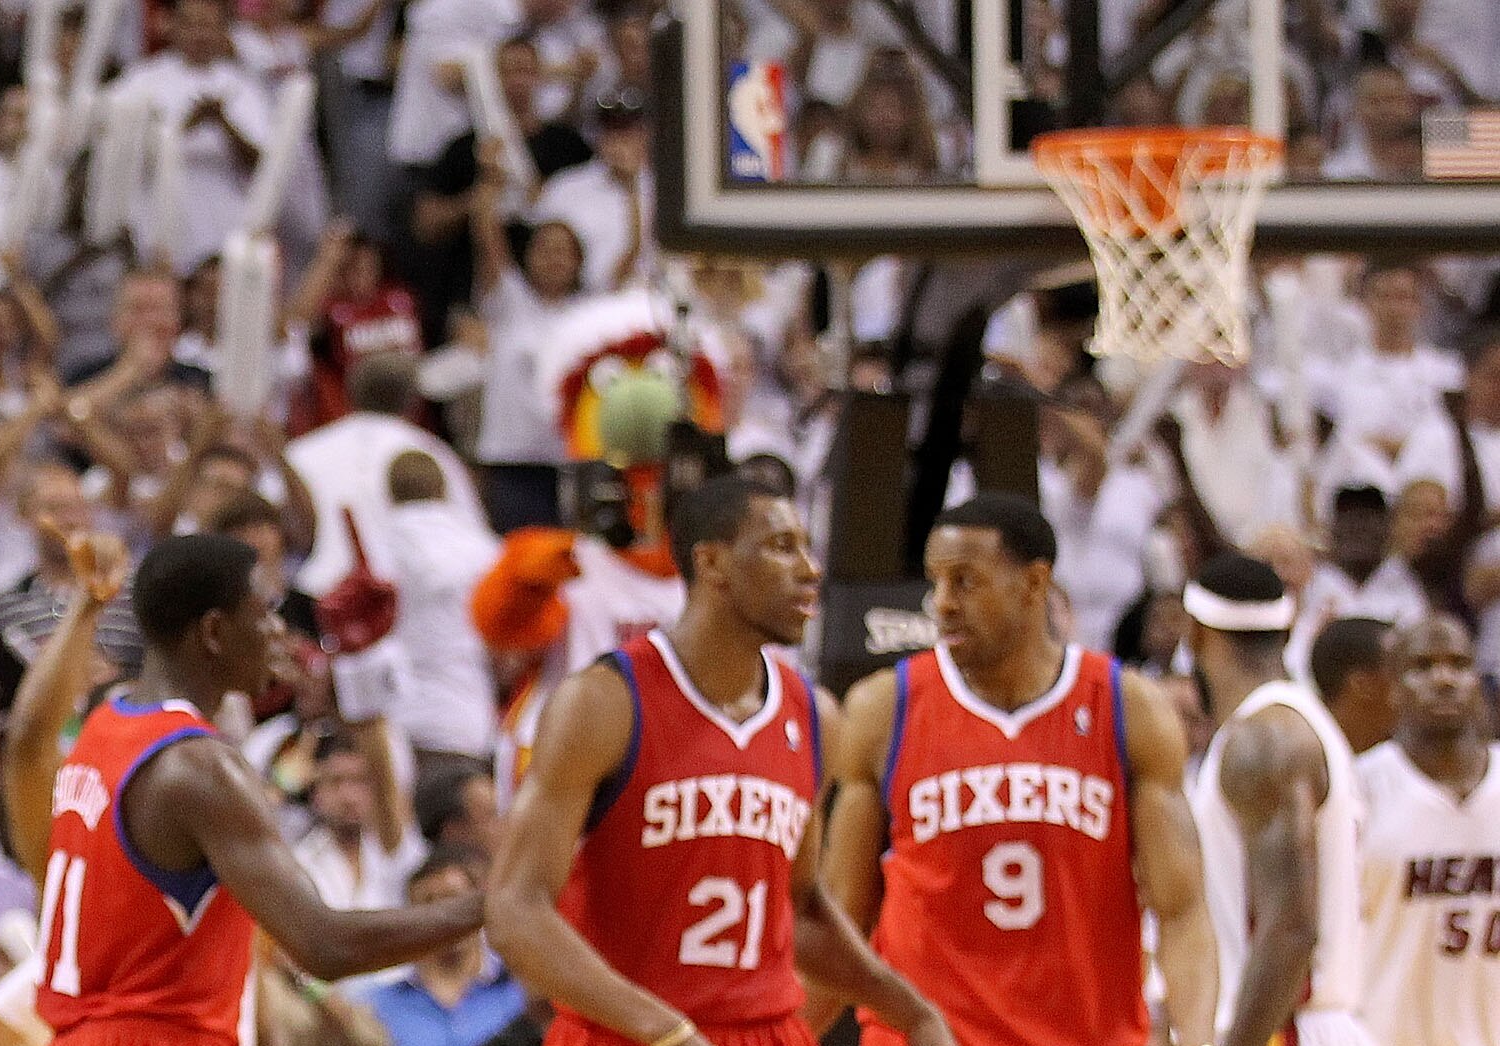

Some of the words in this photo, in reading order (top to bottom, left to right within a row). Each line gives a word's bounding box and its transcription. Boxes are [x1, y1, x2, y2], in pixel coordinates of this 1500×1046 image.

[908, 762, 1114, 844] SIXERS
[981, 841, 1046, 932] 9
[1403, 856, 1500, 898] HEA
[34, 849, 88, 998] 11
[678, 875, 769, 971] 21
